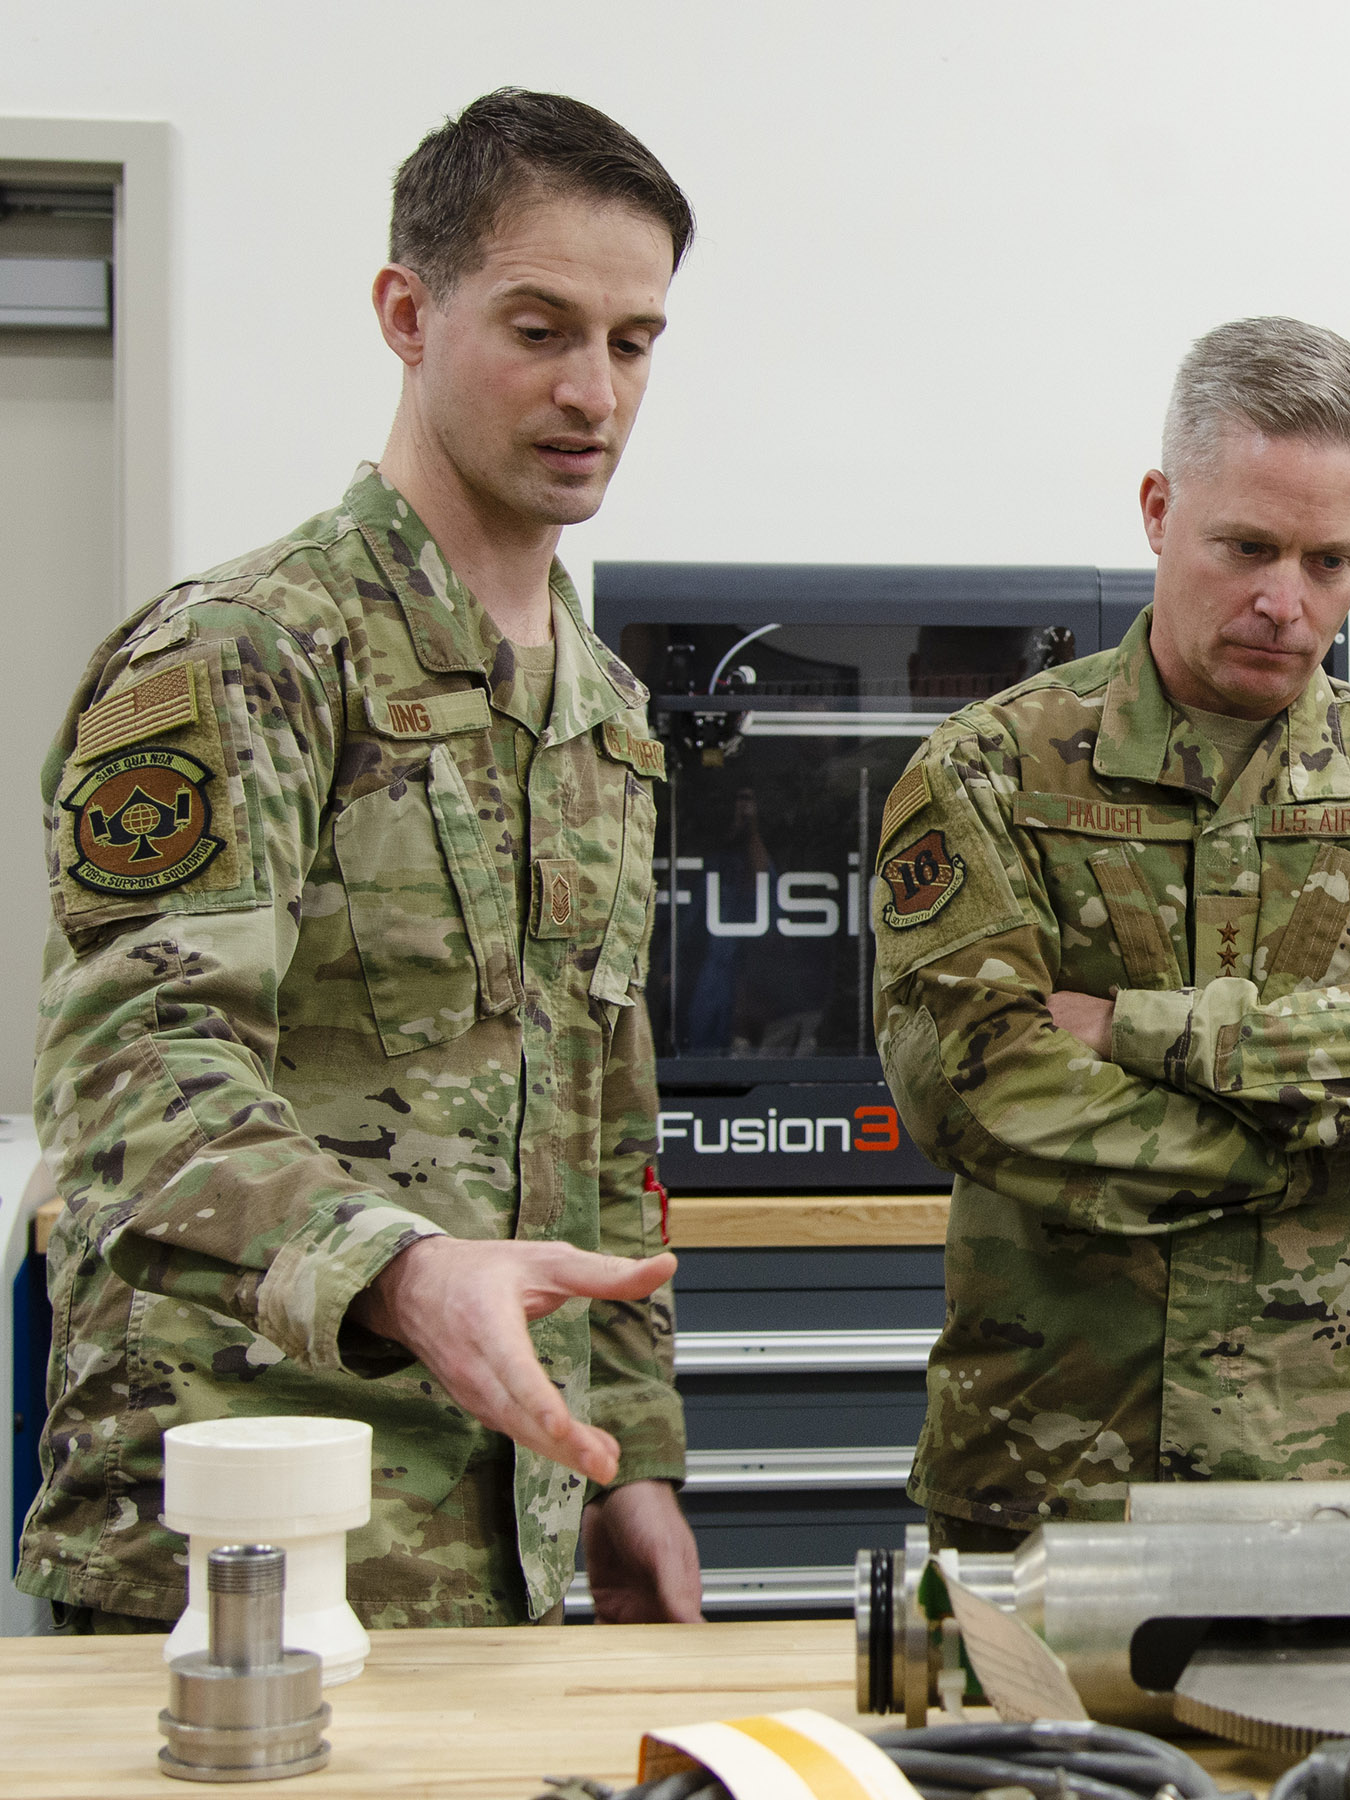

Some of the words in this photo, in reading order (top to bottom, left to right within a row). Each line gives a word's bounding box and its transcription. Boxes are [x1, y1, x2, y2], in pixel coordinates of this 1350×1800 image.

[96, 762, 121, 782] SINE
[123, 754, 147, 768] QUA
[150, 754, 174, 765] NON
[1066, 799, 1142, 835] HAUGH
[1271, 808, 1313, 833] U.S.
[108, 876, 161, 888] SUPPORT
[164, 840, 213, 881] SQUADRON
[897, 850, 940, 900] 16
[656, 1105, 900, 1153] Fusion3
